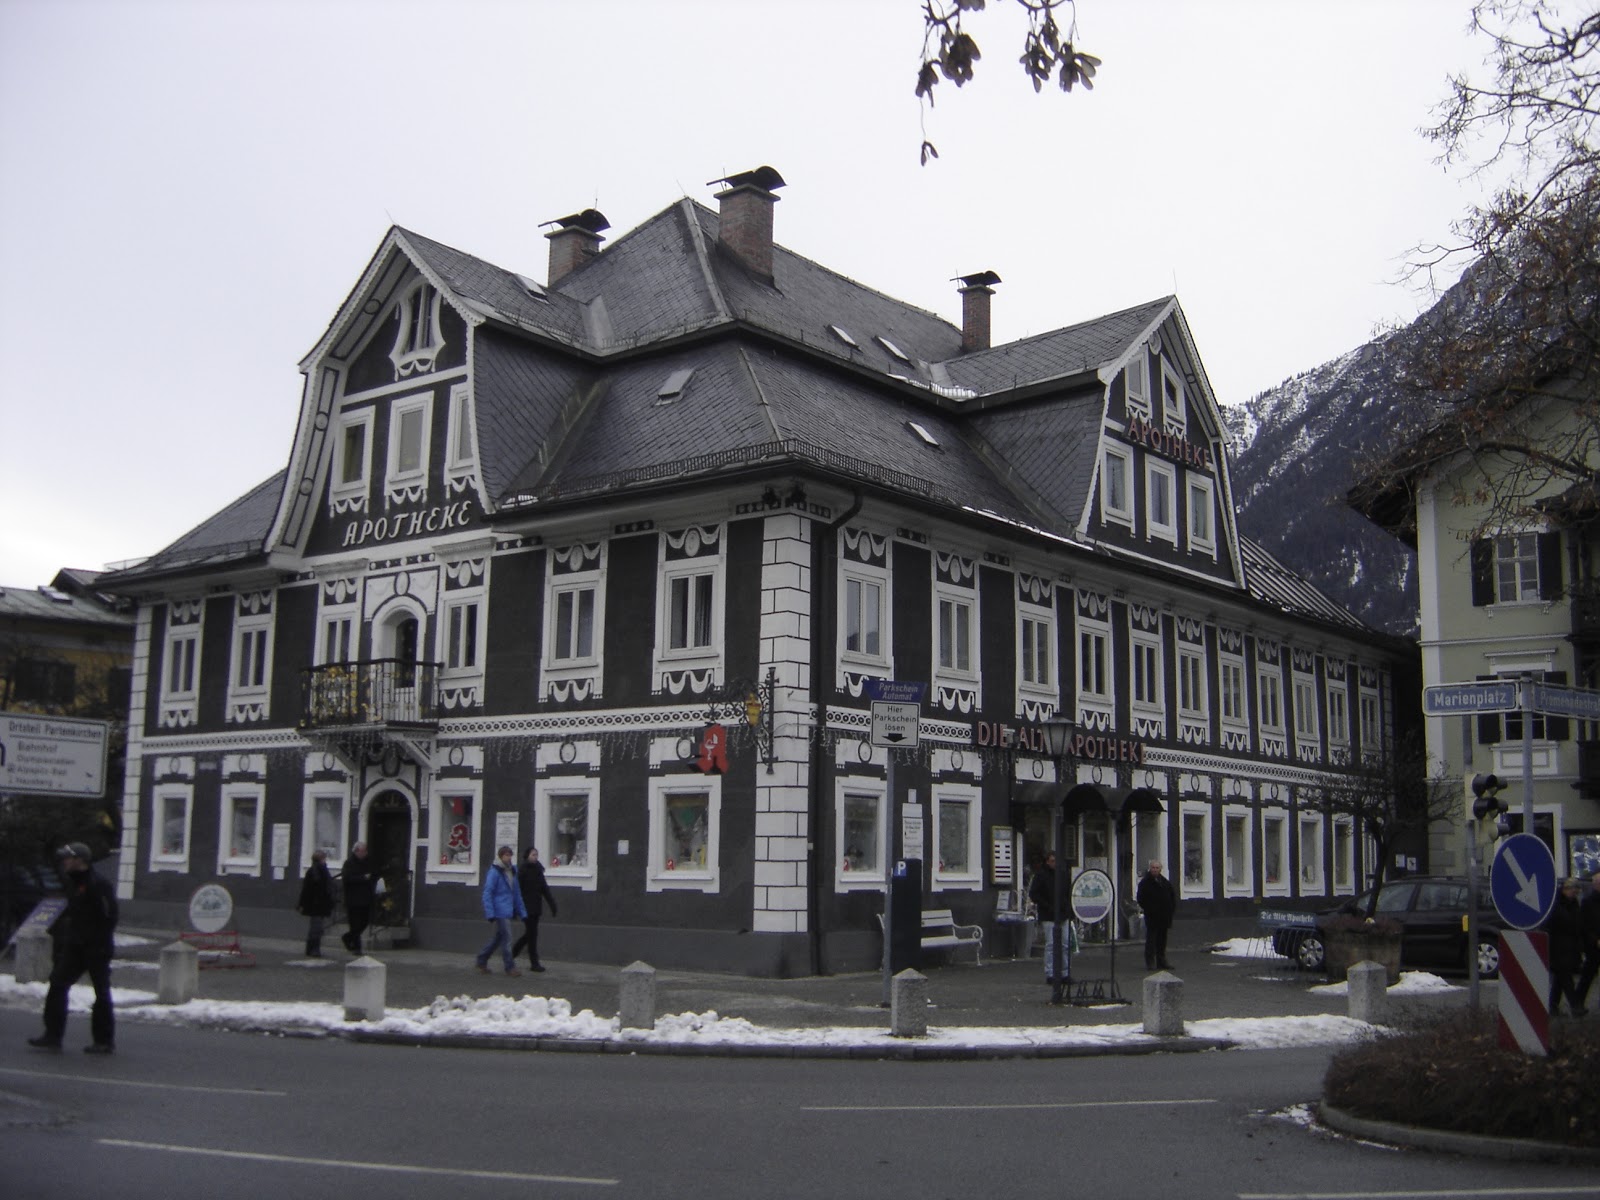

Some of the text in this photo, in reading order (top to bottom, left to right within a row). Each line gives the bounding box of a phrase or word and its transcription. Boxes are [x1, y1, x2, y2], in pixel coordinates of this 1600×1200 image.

[1128, 417, 1210, 468] APOTHEKE
[342, 500, 472, 547] APOTHEKE
[878, 682, 919, 692] Parkschein
[882, 692, 913, 701] Automat
[1434, 690, 1507, 708] Marienplatz
[887, 705, 903, 713] Hier
[874, 714, 917, 723] Parkschein
[9, 721, 102, 738] Ortsteil Partenkirchen
[885, 723, 906, 731] lösen
[977, 721, 1008, 748] DIE
[1019, 726, 1046, 753] ALT
[18, 741, 58, 752] Bahnhof
[897, 861, 906, 875] P
[1260, 911, 1313, 923] Die Alte Apotheke
